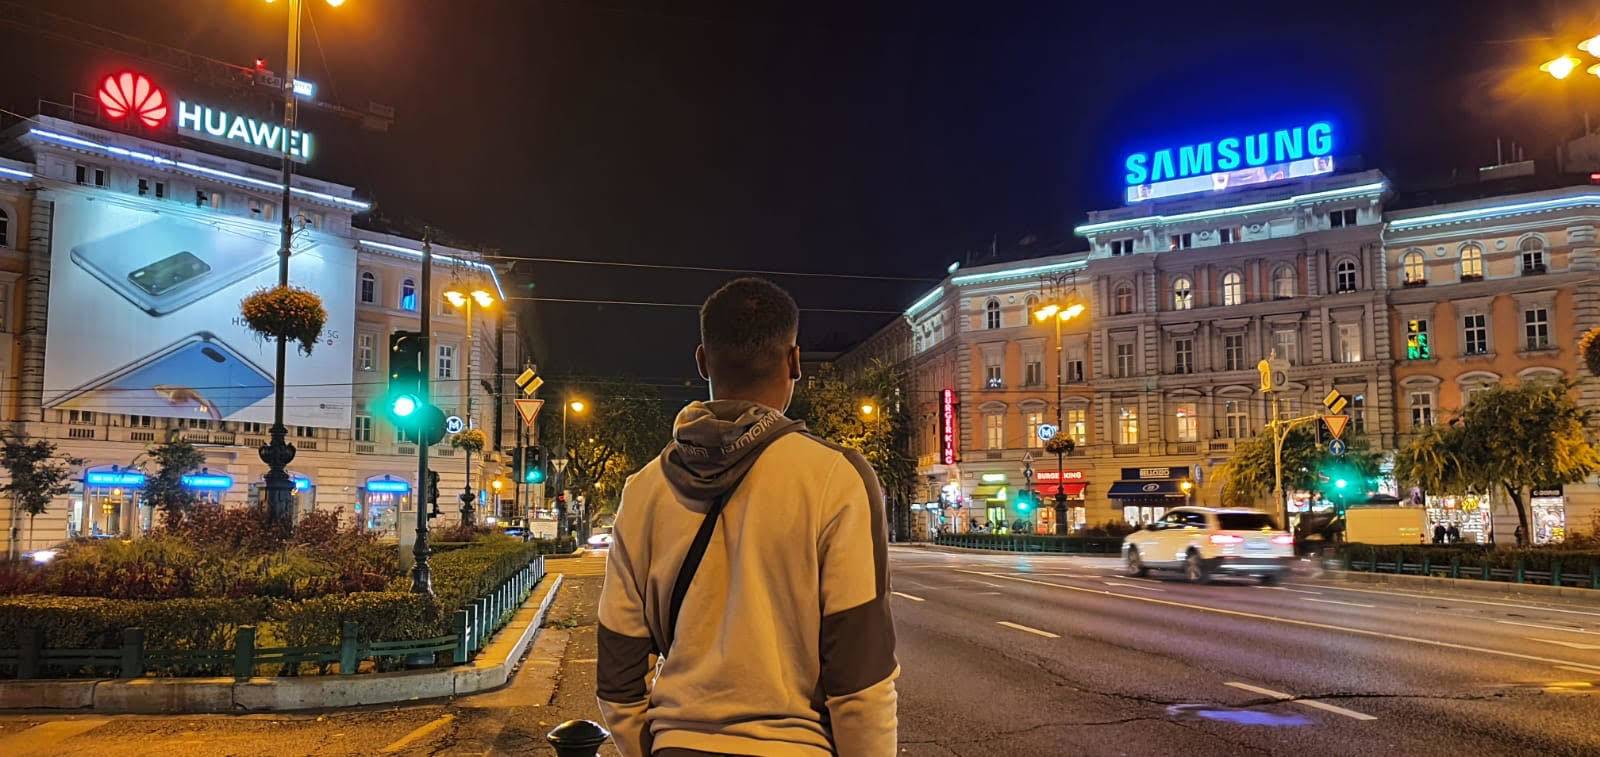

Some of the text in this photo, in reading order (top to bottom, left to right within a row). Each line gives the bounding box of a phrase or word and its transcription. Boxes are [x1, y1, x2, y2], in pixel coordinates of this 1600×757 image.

[178, 100, 310, 158] HUAWEI
[1126, 122, 1332, 184] SAMSUNG
[720, 410, 782, 456] RMOUR
[944, 389, 953, 464] BURGER KING
[1038, 472, 1061, 480] BURGE
